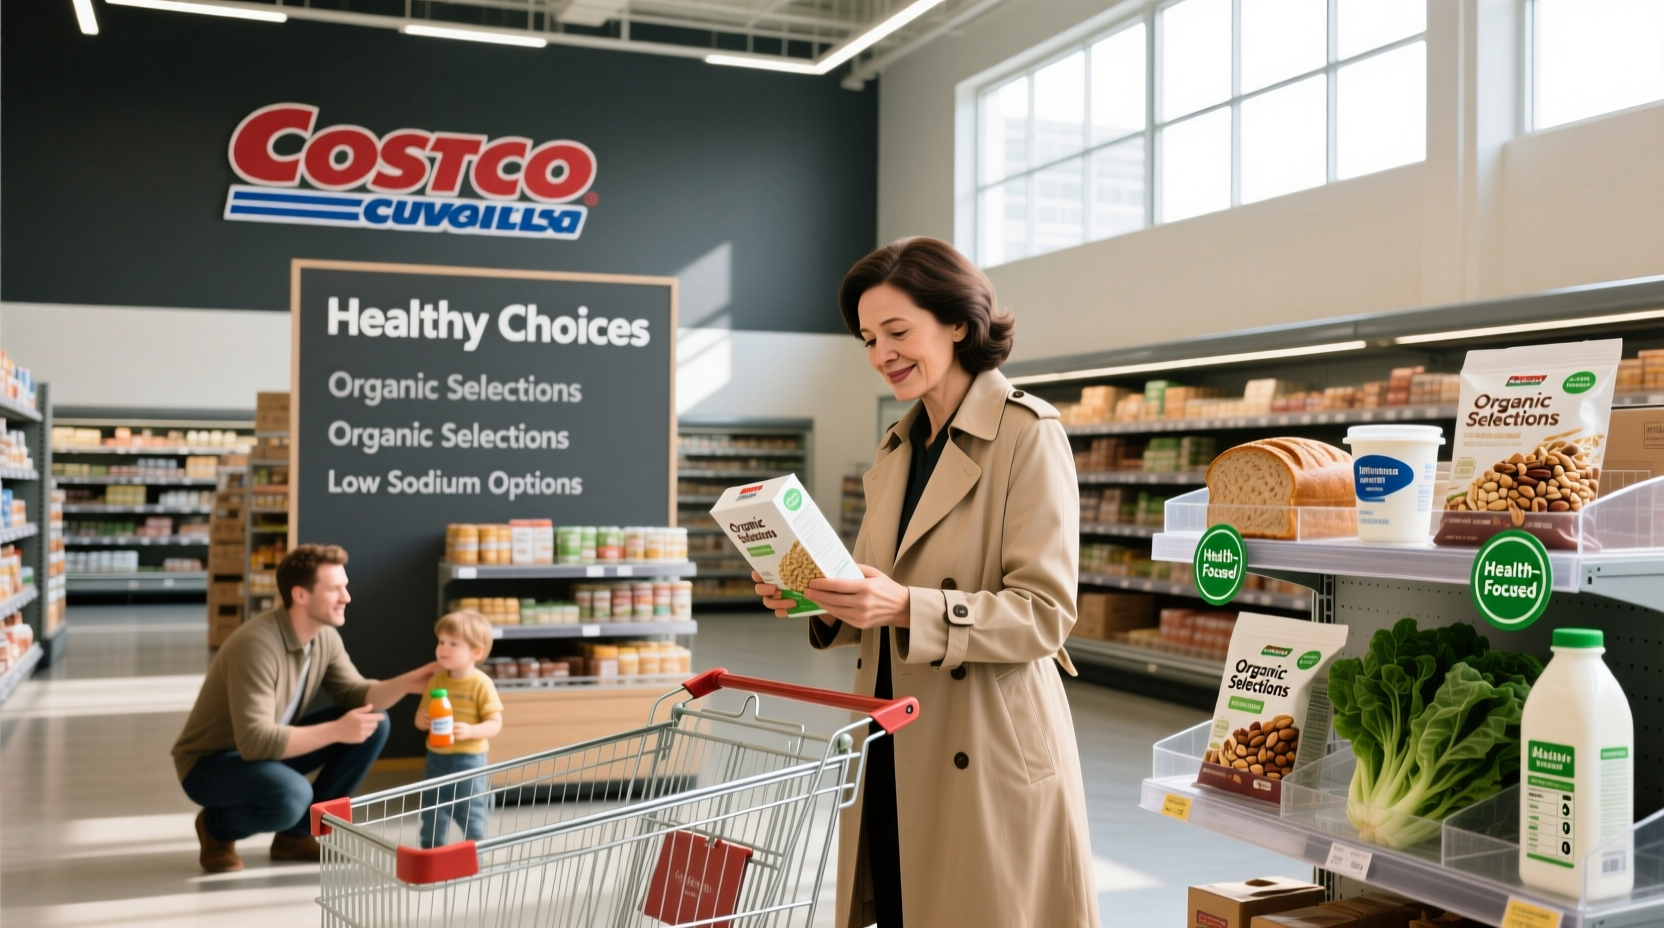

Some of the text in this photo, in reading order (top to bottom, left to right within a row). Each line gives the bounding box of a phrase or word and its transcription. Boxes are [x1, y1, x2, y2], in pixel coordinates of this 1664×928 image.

[229, 103, 597, 203] COSTCO
[327, 297, 651, 351] Healthy Choices
[328, 371, 582, 406] Organic Selections
[1474, 392, 1552, 413] Organic
[1466, 411, 1560, 427] Selections
[328, 420, 570, 454] Organic Selections
[328, 469, 583, 501] Low Sodium Options
[1236, 659, 1288, 680] Organic
[1228, 675, 1291, 698] Selections
